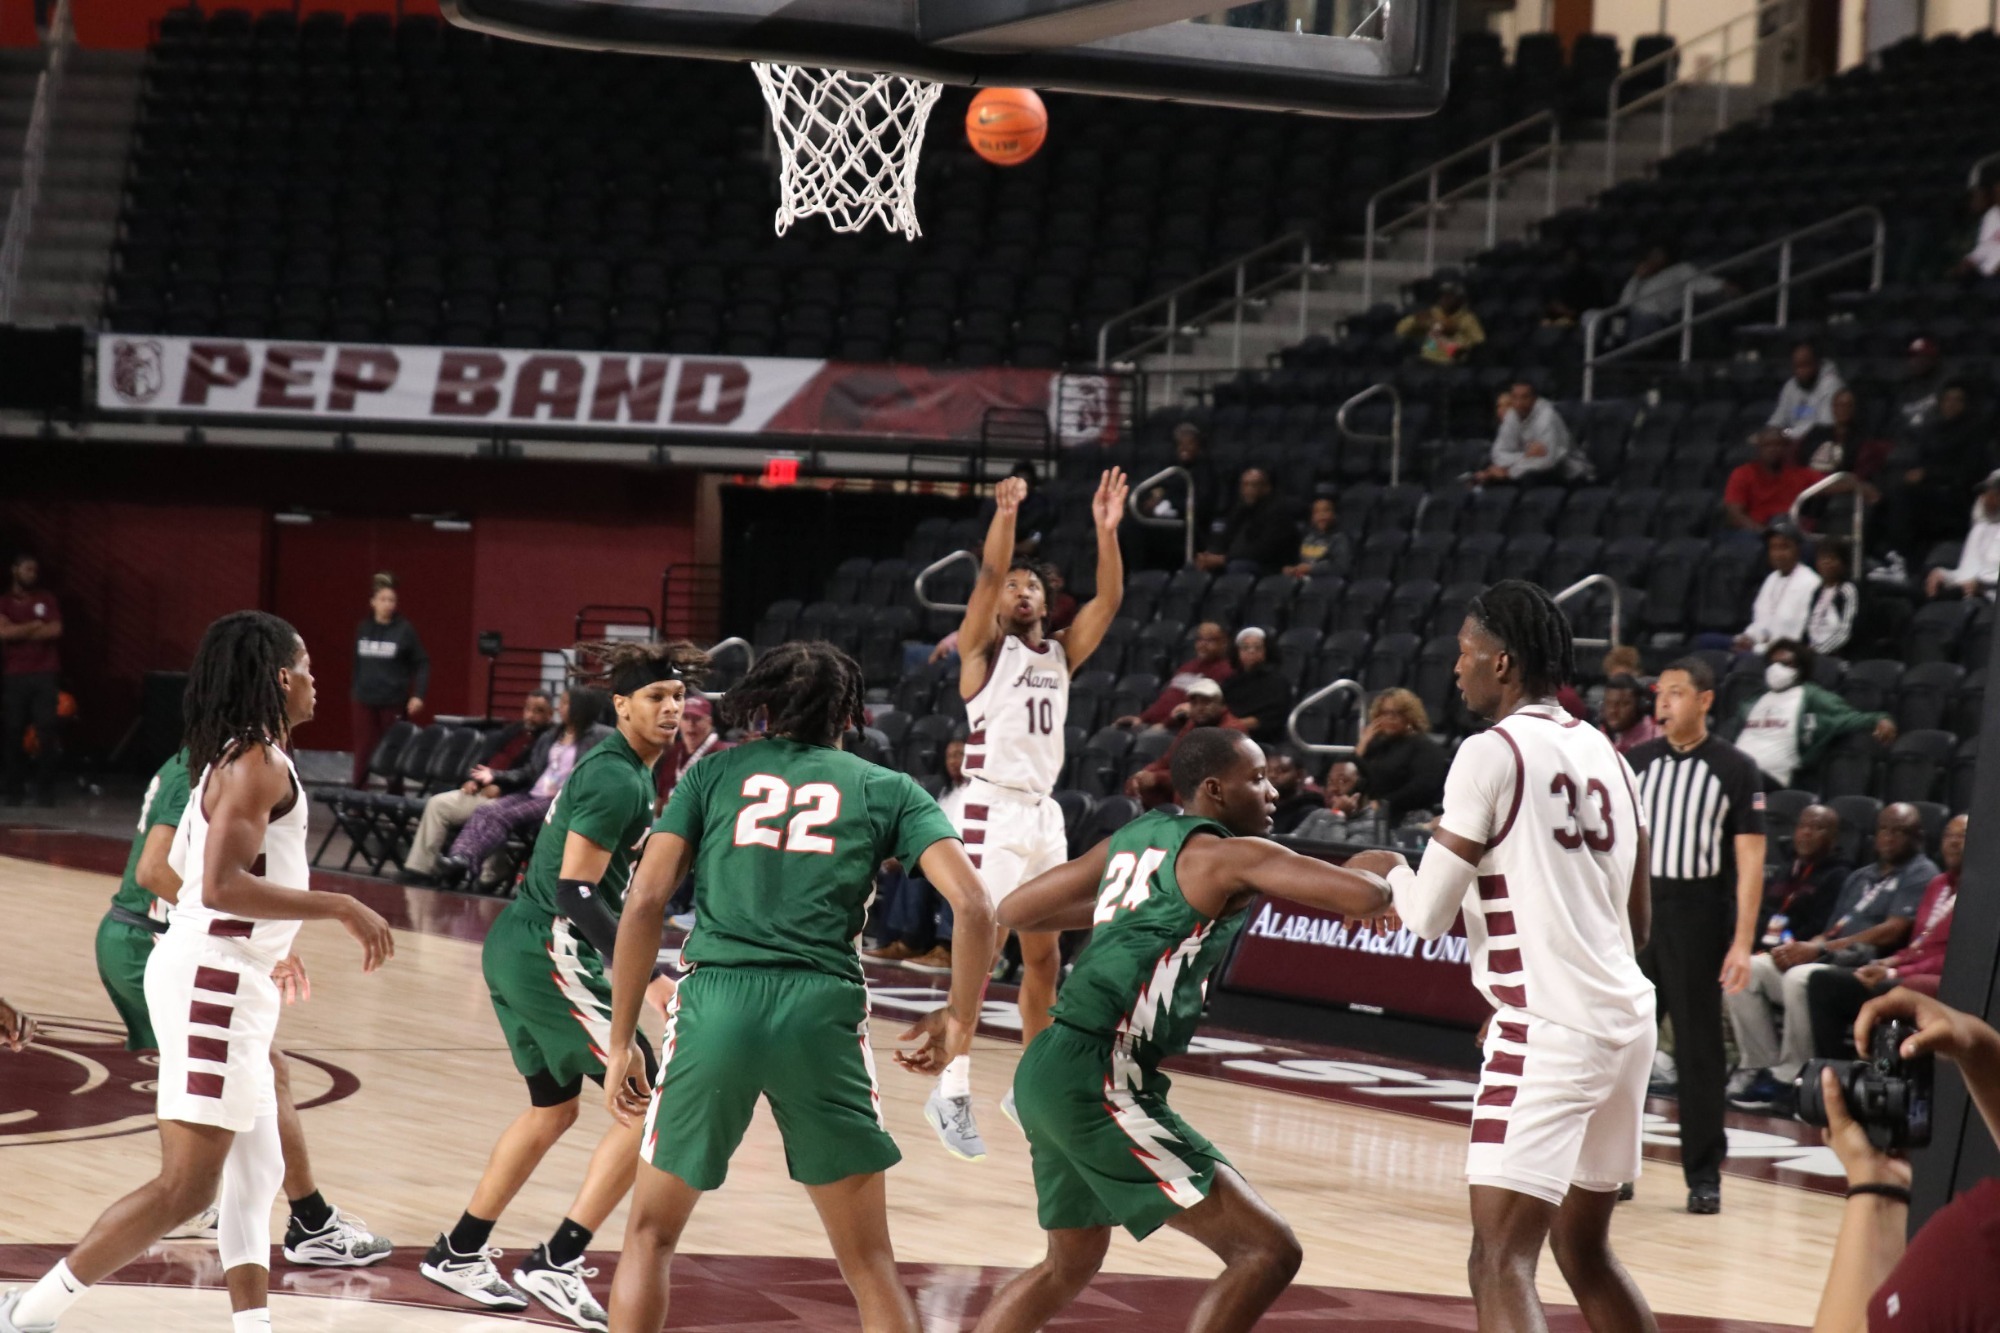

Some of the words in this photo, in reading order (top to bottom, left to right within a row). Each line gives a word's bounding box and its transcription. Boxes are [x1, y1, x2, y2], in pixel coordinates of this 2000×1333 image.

[178, 341, 399, 411] PEP
[430, 350, 751, 425] BAND
[1025, 697, 1053, 736] 10
[733, 772, 842, 854] 22
[1549, 772, 1616, 854] 33
[1093, 846, 1168, 927] 24
[1248, 902, 1348, 949] ALABAMA
